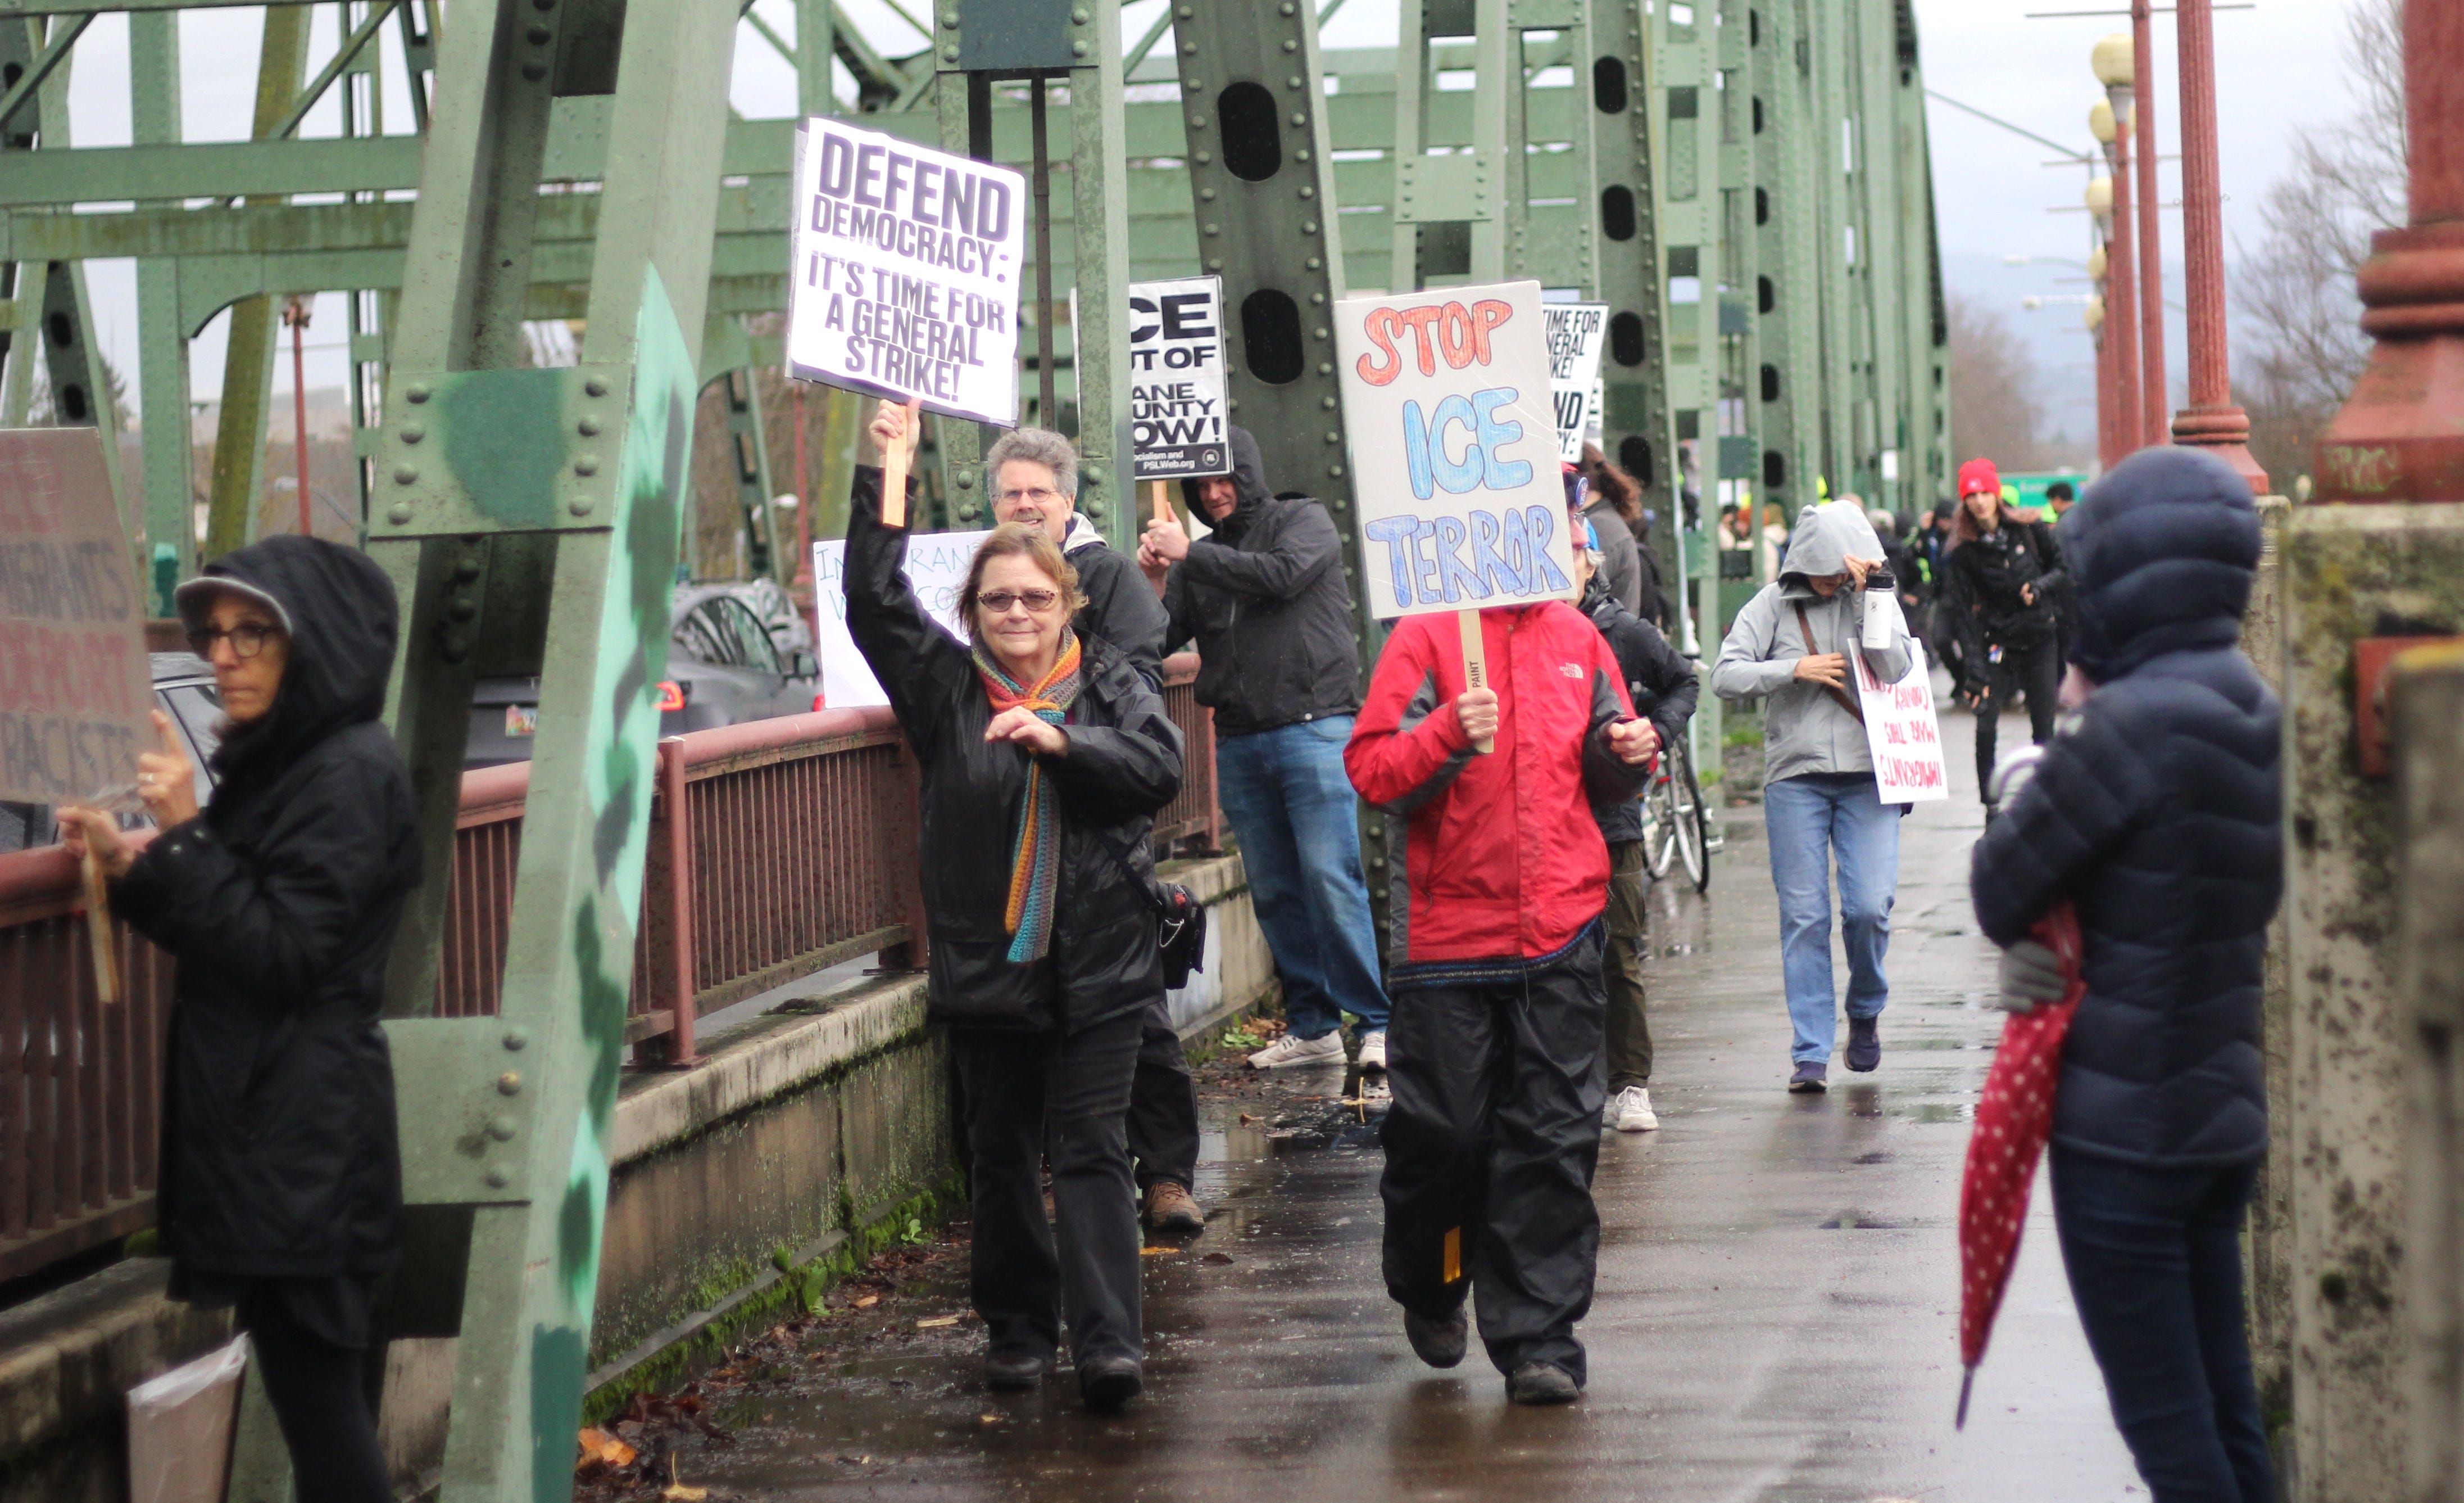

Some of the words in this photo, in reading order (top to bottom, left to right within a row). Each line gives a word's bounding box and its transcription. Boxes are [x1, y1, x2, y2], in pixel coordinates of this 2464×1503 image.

[819, 132, 1010, 242] DEFEND
[811, 193, 1009, 283] DEMOCRACY:
[808, 250, 865, 297] IT'S
[872, 266, 941, 320] TIME
[946, 286, 1005, 334] FOR
[824, 292, 845, 332] A
[852, 298, 984, 366] GENERAL
[1129, 292, 1216, 343] CE
[1573, 310, 1600, 333] FOR
[1356, 299, 1513, 386] STOP
[1546, 332, 1586, 355] NERAL
[845, 334, 961, 402] STRIKE!
[1164, 345, 1217, 369] OF
[1550, 355, 1574, 378] IKE!
[1132, 383, 1196, 402] ANE
[1133, 398, 1217, 419] UNTY
[1134, 417, 1220, 449] OW!
[1403, 386, 1533, 500] ICE
[1134, 451, 1166, 461] ocialism
[1143, 460, 1195, 470] PSLWeb.org
[1365, 505, 1572, 607] TERROR
[1469, 660, 1481, 687] PAINT
[1895, 684, 1928, 711] COUNTRY
[1884, 721, 1907, 744] THIS
[1909, 719, 1935, 744] MAKE
[1880, 754, 1941, 788] IMMIGRANTS
